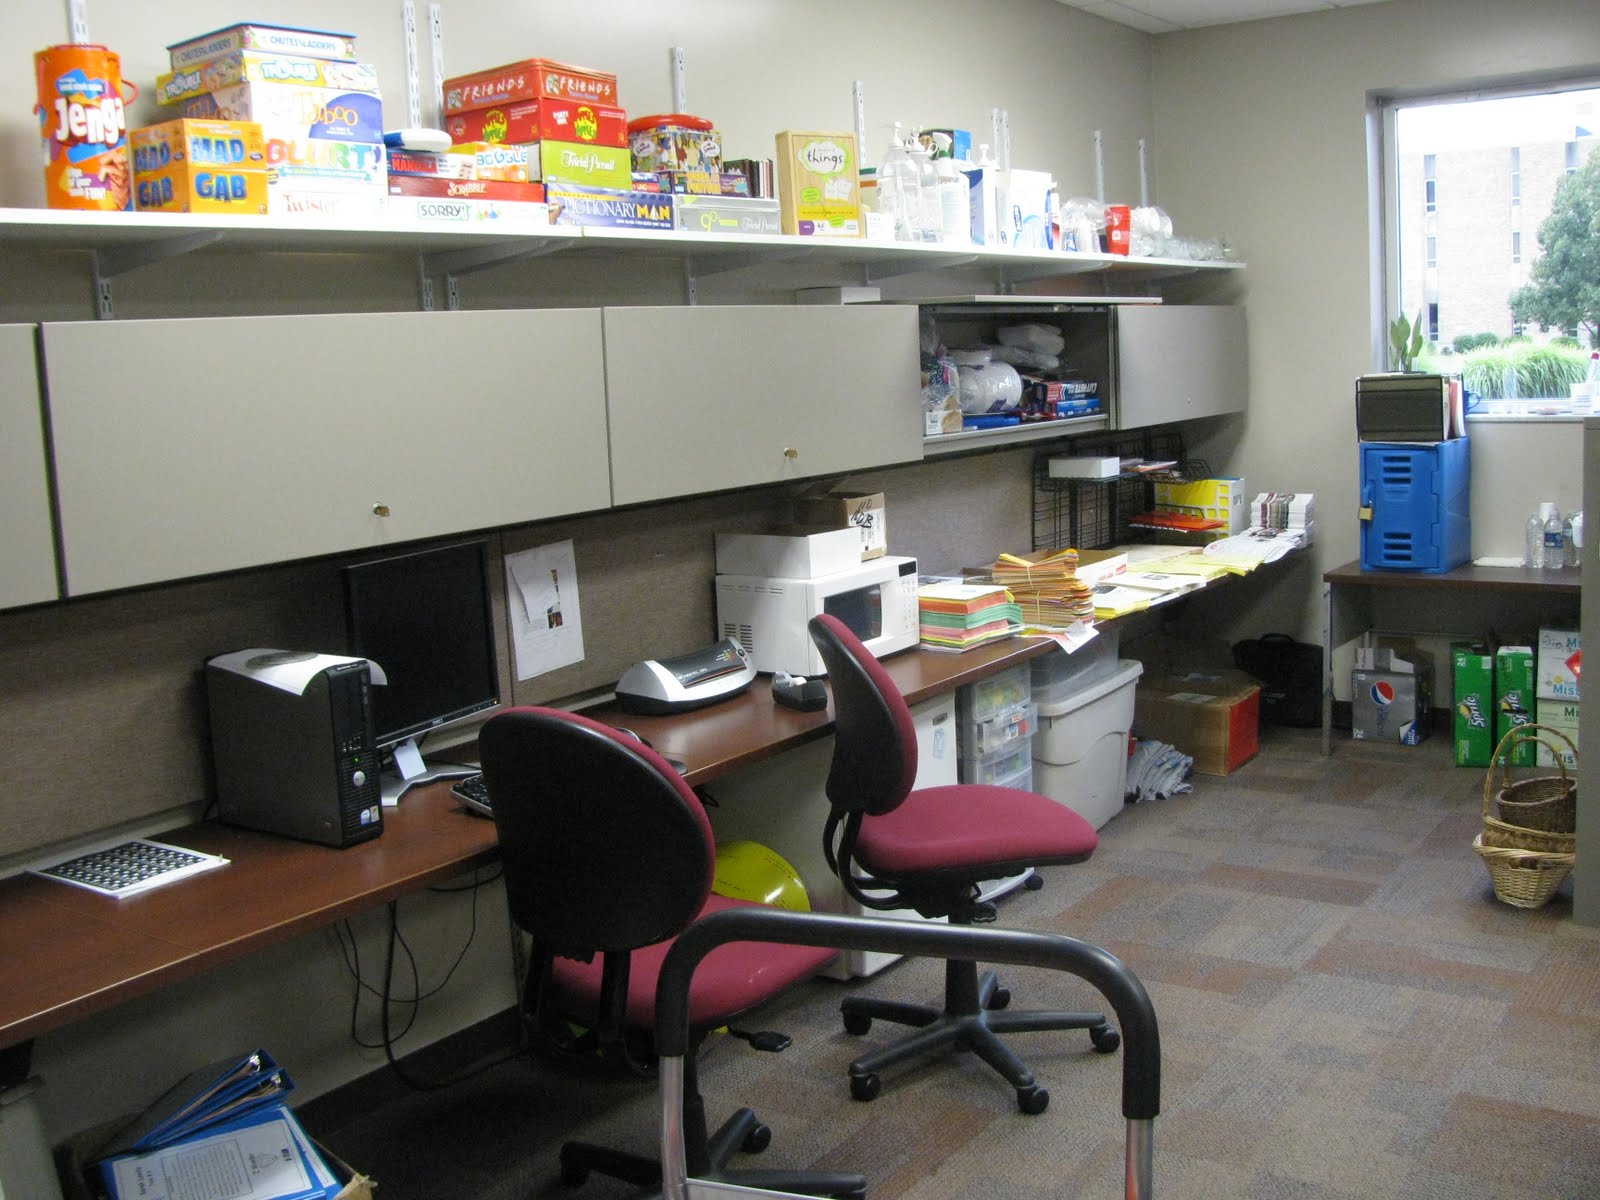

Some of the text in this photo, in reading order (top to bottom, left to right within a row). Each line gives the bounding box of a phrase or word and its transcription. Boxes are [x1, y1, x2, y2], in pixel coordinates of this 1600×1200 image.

[303, 40, 336, 51] LADDERS
[55, 97, 126, 144] Jenga
[134, 141, 171, 174] MAD
[189, 136, 246, 164] MAD
[476, 149, 528, 166] BOGGLE
[807, 148, 843, 170] things
[137, 176, 174, 208] GAB
[194, 172, 247, 203] GAB
[564, 198, 671, 221] PICTIONARY MAN
[1466, 696, 1485, 728] Sprite
